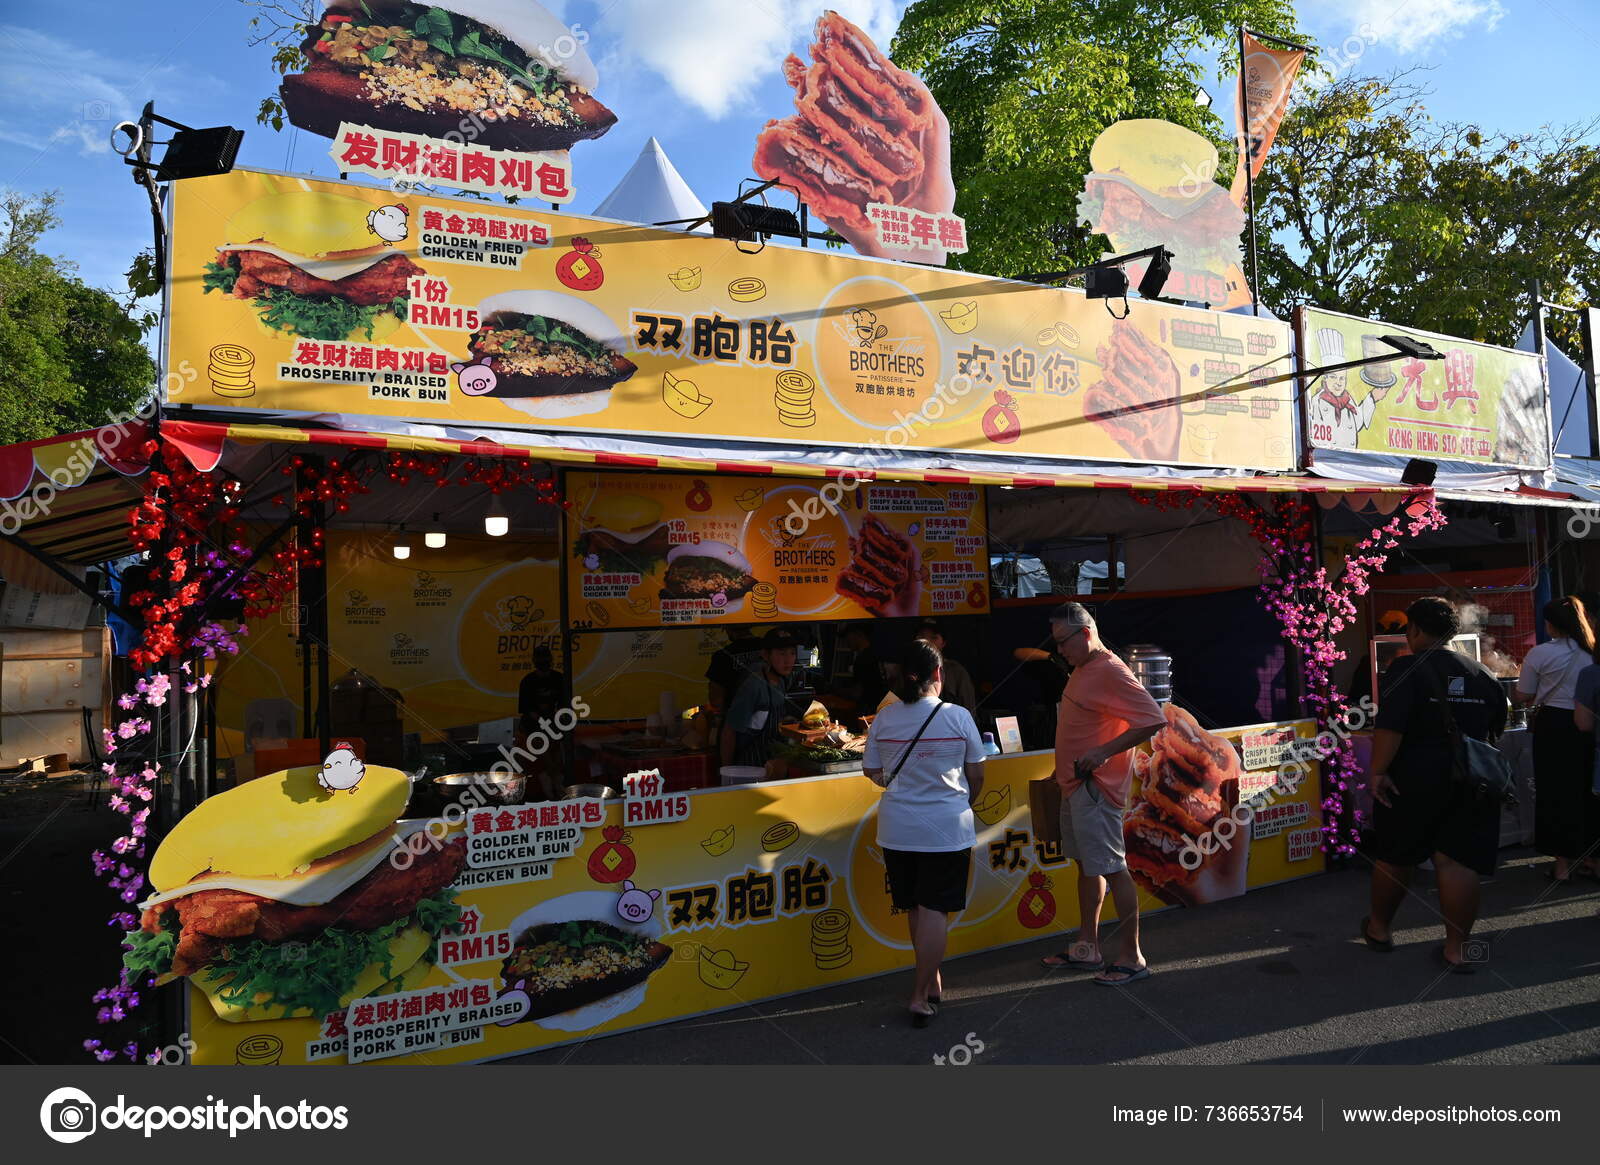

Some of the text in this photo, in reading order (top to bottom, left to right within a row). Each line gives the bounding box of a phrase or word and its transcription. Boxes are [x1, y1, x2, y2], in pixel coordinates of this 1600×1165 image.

[423, 211, 549, 245] 黄金鸡腿刈包
[423, 234, 524, 255] GOLDEN FRIED
[423, 247, 517, 267] CHICKEN BUN
[411, 279, 448, 304] 1份
[411, 305, 478, 330] RM15
[635, 314, 796, 364] 双胞胎
[879, 344, 894, 352] THE
[850, 350, 925, 377] BROTHERS
[957, 344, 1078, 392] 欢迎你
[281, 366, 447, 388] PROSPERITY BRAISED
[371, 385, 447, 401] PORK BUN
[1313, 423, 1332, 441] 208
[1389, 428, 1412, 449] KONG
[1417, 431, 1438, 452] HENG
[669, 532, 700, 545] RM15
[774, 550, 836, 567] BROTHERS
[414, 589, 452, 598] BROTHERS
[345, 607, 386, 617] BROTHERS
[390, 648, 429, 658] BROTHERS
[1245, 749, 1267, 759] CRISPY
[1246, 757, 1267, 768] CREAM
[627, 774, 659, 797] 1份
[471, 803, 602, 836] 黄金鸡腿刈包
[628, 797, 687, 822] RM15
[471, 832, 529, 850] GOLDEN
[536, 827, 576, 843] FRIED
[471, 842, 570, 864] CHICKEN BUN
[1290, 846, 1310, 859] RM10
[521, 864, 548, 878] BUN
[668, 860, 829, 926] 双胞胎
[442, 933, 510, 964] RM15
[353, 1001, 523, 1043] PROSPERITY BRAISED
[353, 1028, 480, 1057] PORK BUN BUN
